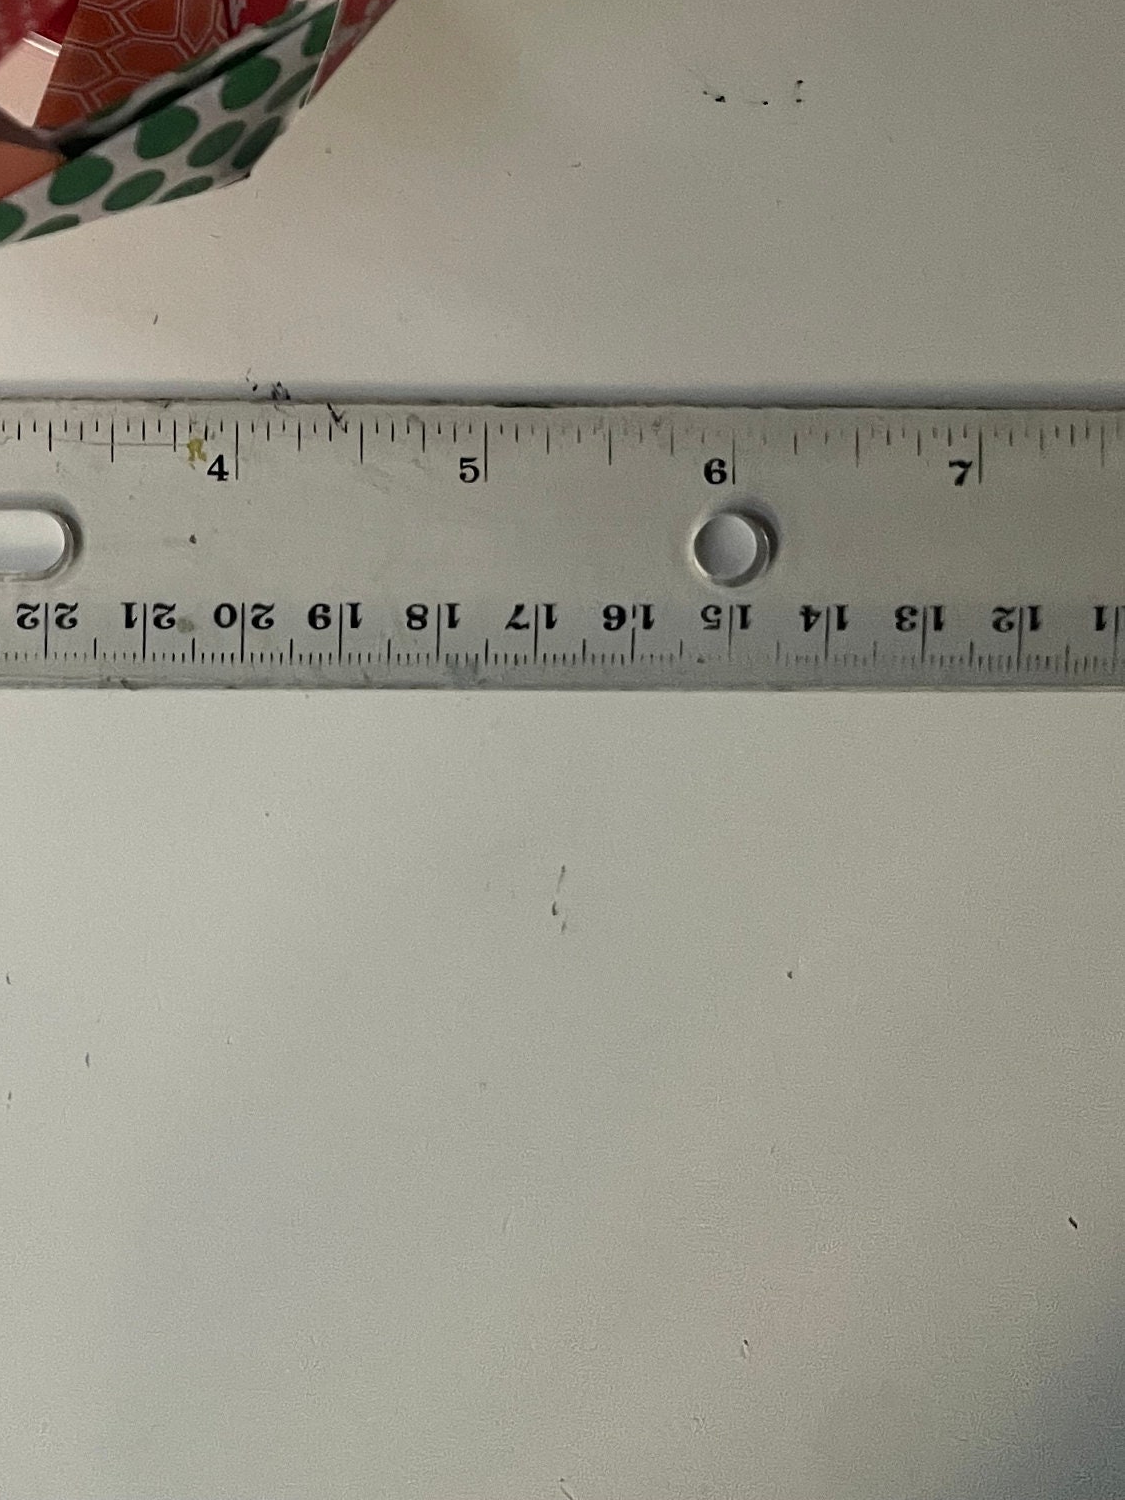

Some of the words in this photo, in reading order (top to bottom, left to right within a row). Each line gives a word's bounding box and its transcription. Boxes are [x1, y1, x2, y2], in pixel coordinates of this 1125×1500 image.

[207, 454, 229, 481] 4
[459, 457, 480, 483] 5
[703, 458, 727, 485] 6
[948, 460, 973, 486] 7
[16, 603, 79, 630] 22
[121, 602, 176, 630] 21
[213, 603, 275, 630] 20
[307, 602, 363, 630] 19
[405, 603, 461, 630] 18
[505, 603, 558, 630] 17
[602, 604, 655, 631] 16
[701, 604, 752, 631] 15
[799, 604, 849, 632] 14
[894, 605, 946, 632] 13
[992, 605, 1042, 632] 12
